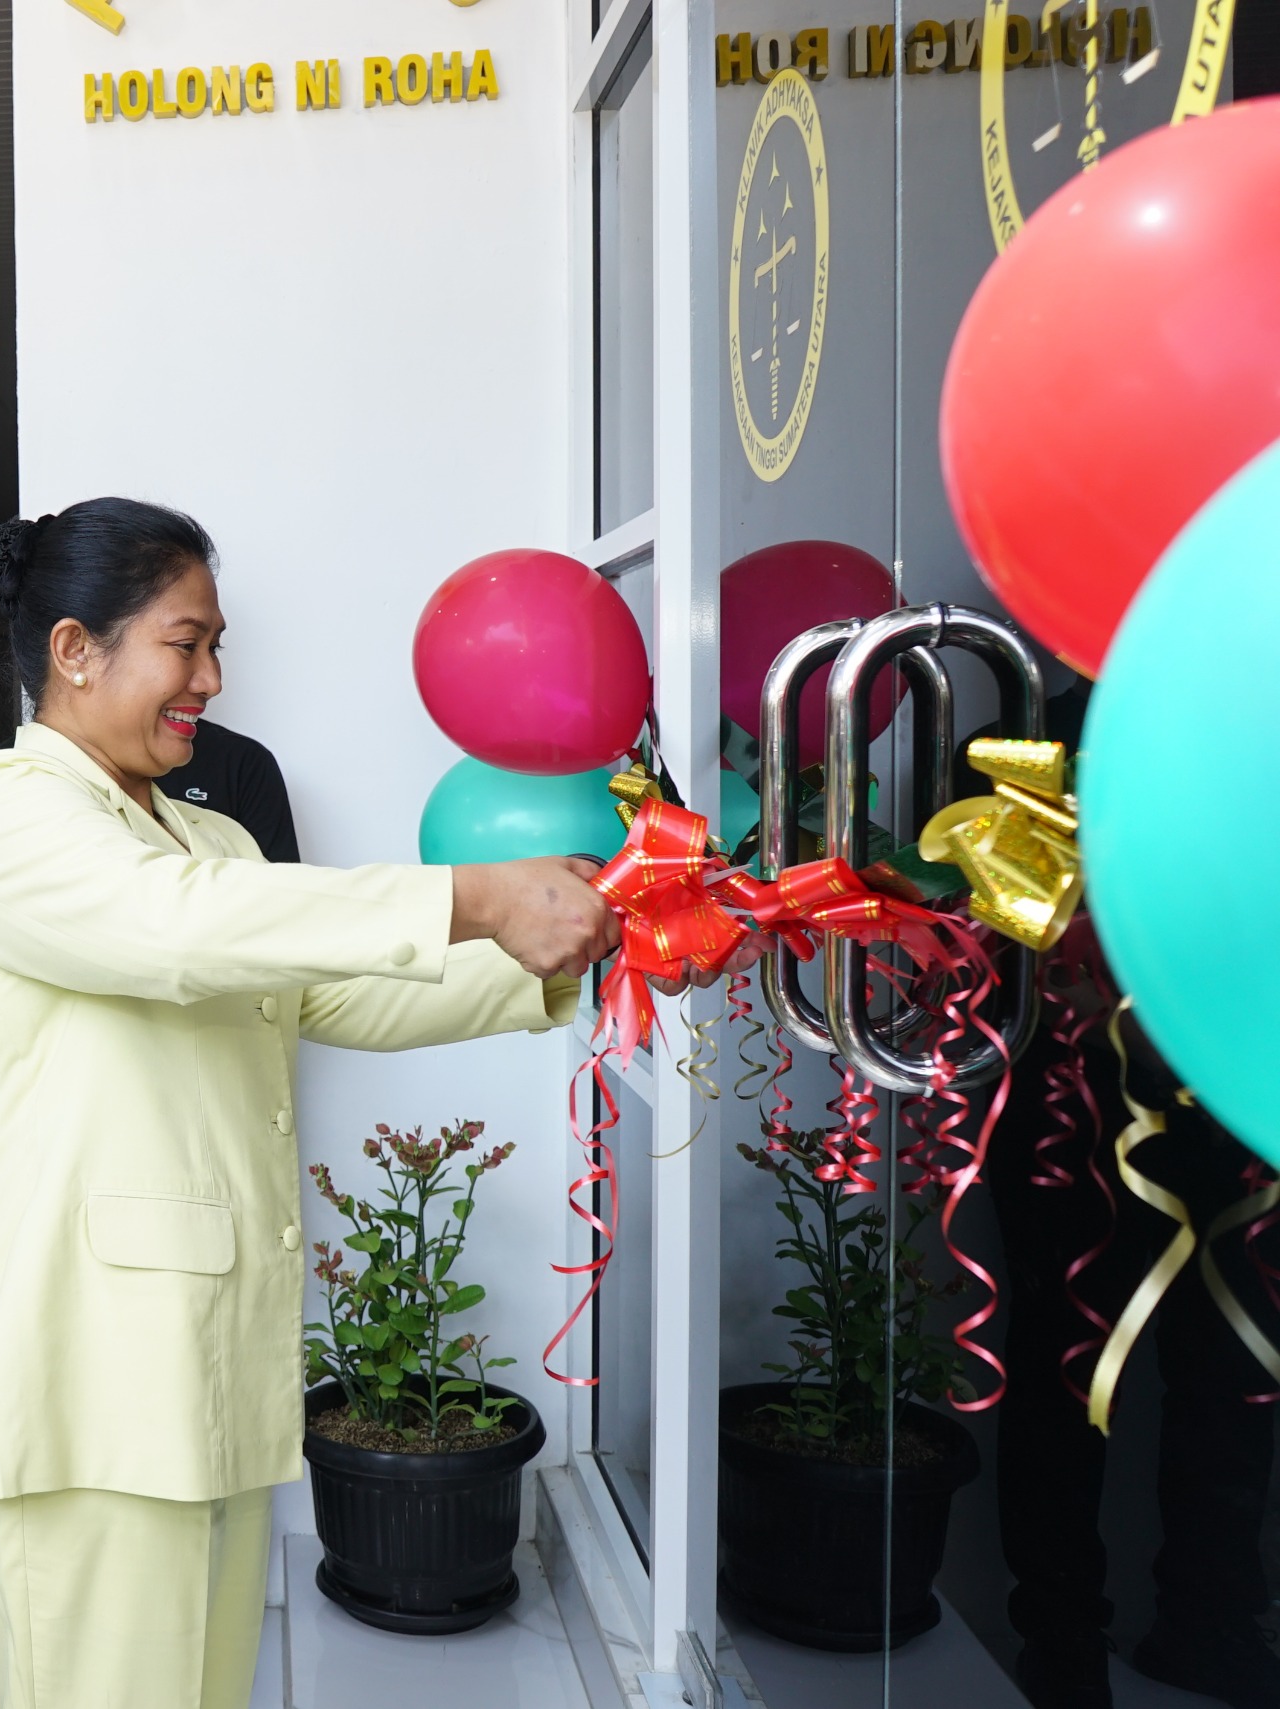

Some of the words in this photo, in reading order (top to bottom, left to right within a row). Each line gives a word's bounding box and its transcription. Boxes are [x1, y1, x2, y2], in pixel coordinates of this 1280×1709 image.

[84, 62, 275, 124] HOLONG
[296, 58, 341, 111] NI
[363, 48, 499, 109] ROHA
[738, 111, 765, 214] KLINIK
[765, 77, 816, 145] ADHYAKSA
[731, 333, 756, 456] KEJAKSAAN
[754, 441, 778, 470] TINGGI
[778, 361, 815, 463] SUMATERA
[812, 251, 827, 353] UTARA
